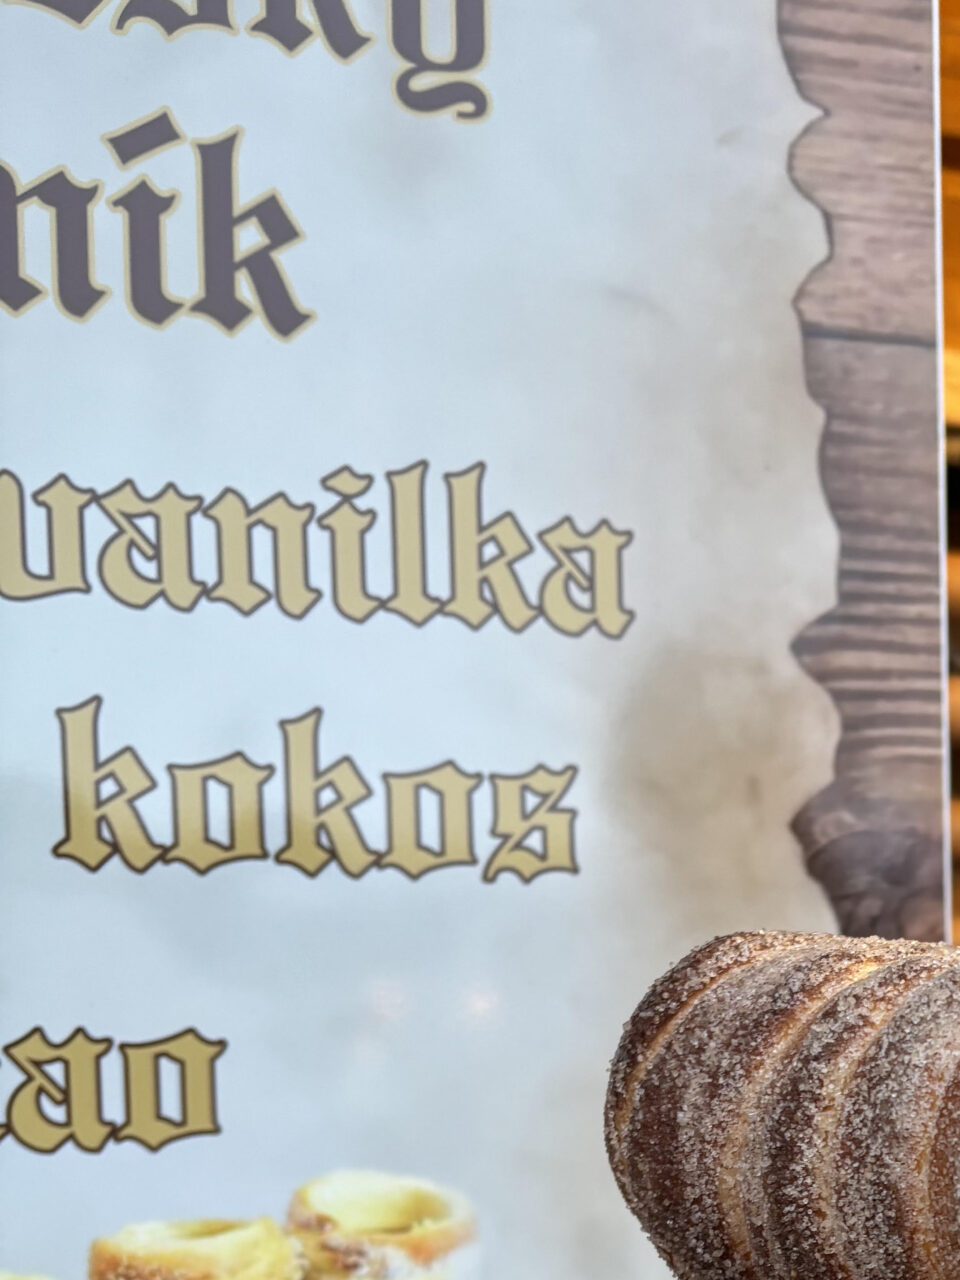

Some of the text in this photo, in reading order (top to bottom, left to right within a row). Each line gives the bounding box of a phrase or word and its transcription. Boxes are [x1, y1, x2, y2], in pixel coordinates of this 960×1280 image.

[0, 460, 636, 640] vanilka
[52, 694, 580, 884] kokos
[0, 1026, 228, 1154] ao
